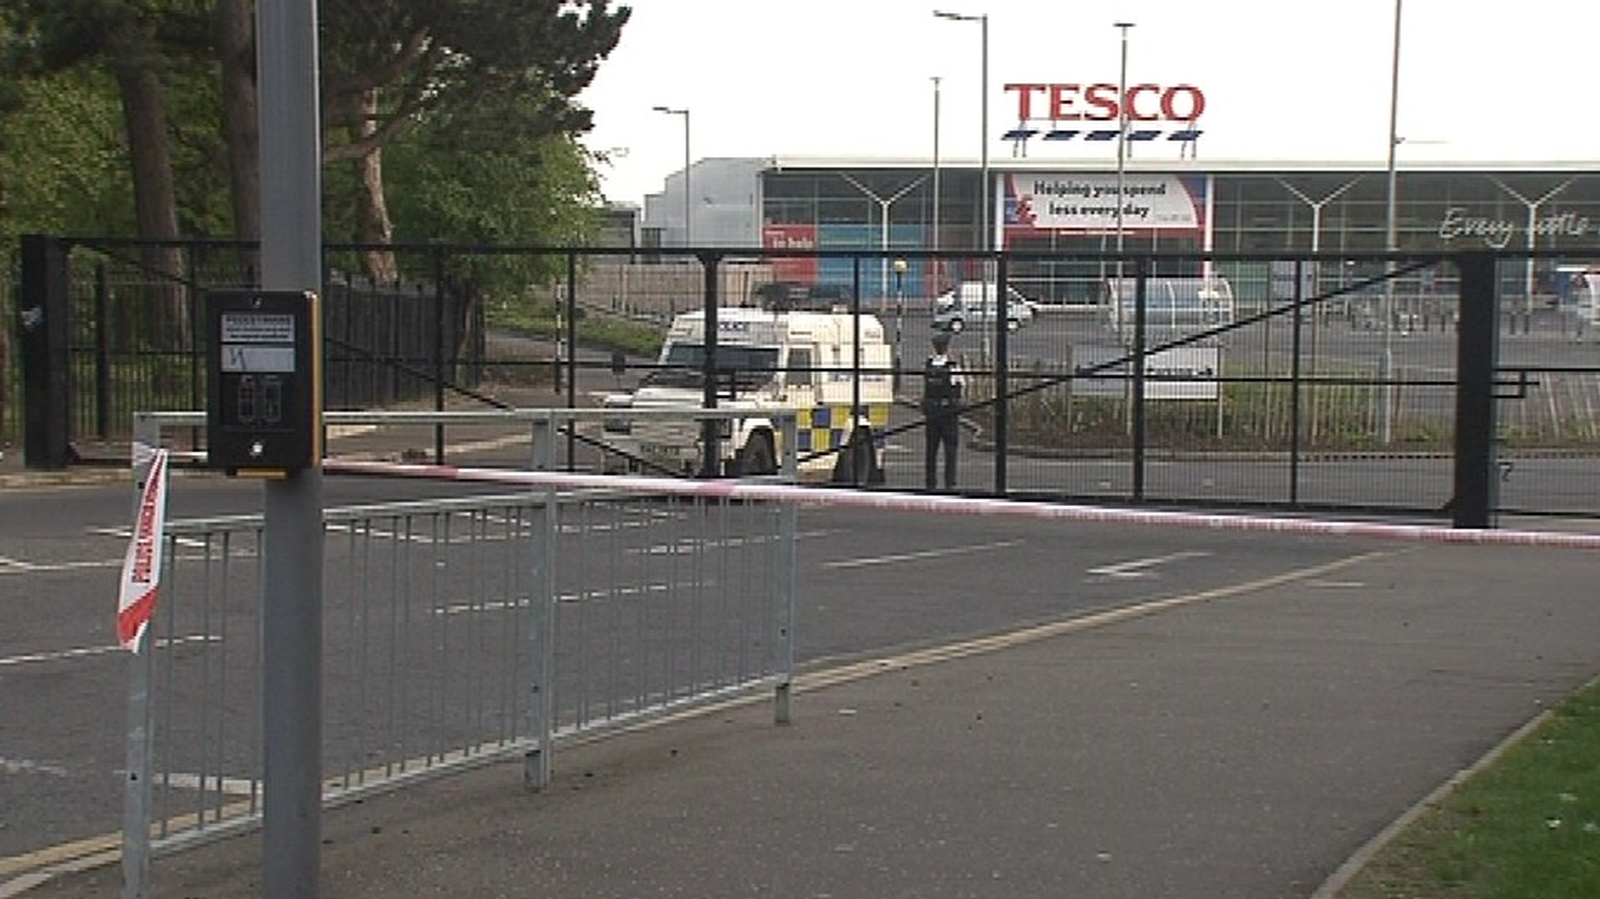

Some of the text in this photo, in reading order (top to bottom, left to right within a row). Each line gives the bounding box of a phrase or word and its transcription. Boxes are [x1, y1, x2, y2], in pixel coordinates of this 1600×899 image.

[1003, 83, 1206, 122] TESCO
[1033, 180, 1167, 199] Helping you spend
[1048, 203, 1078, 216] less
[1080, 205, 1119, 219] every
[1122, 203, 1149, 219] day
[1439, 206, 1514, 249] Every
